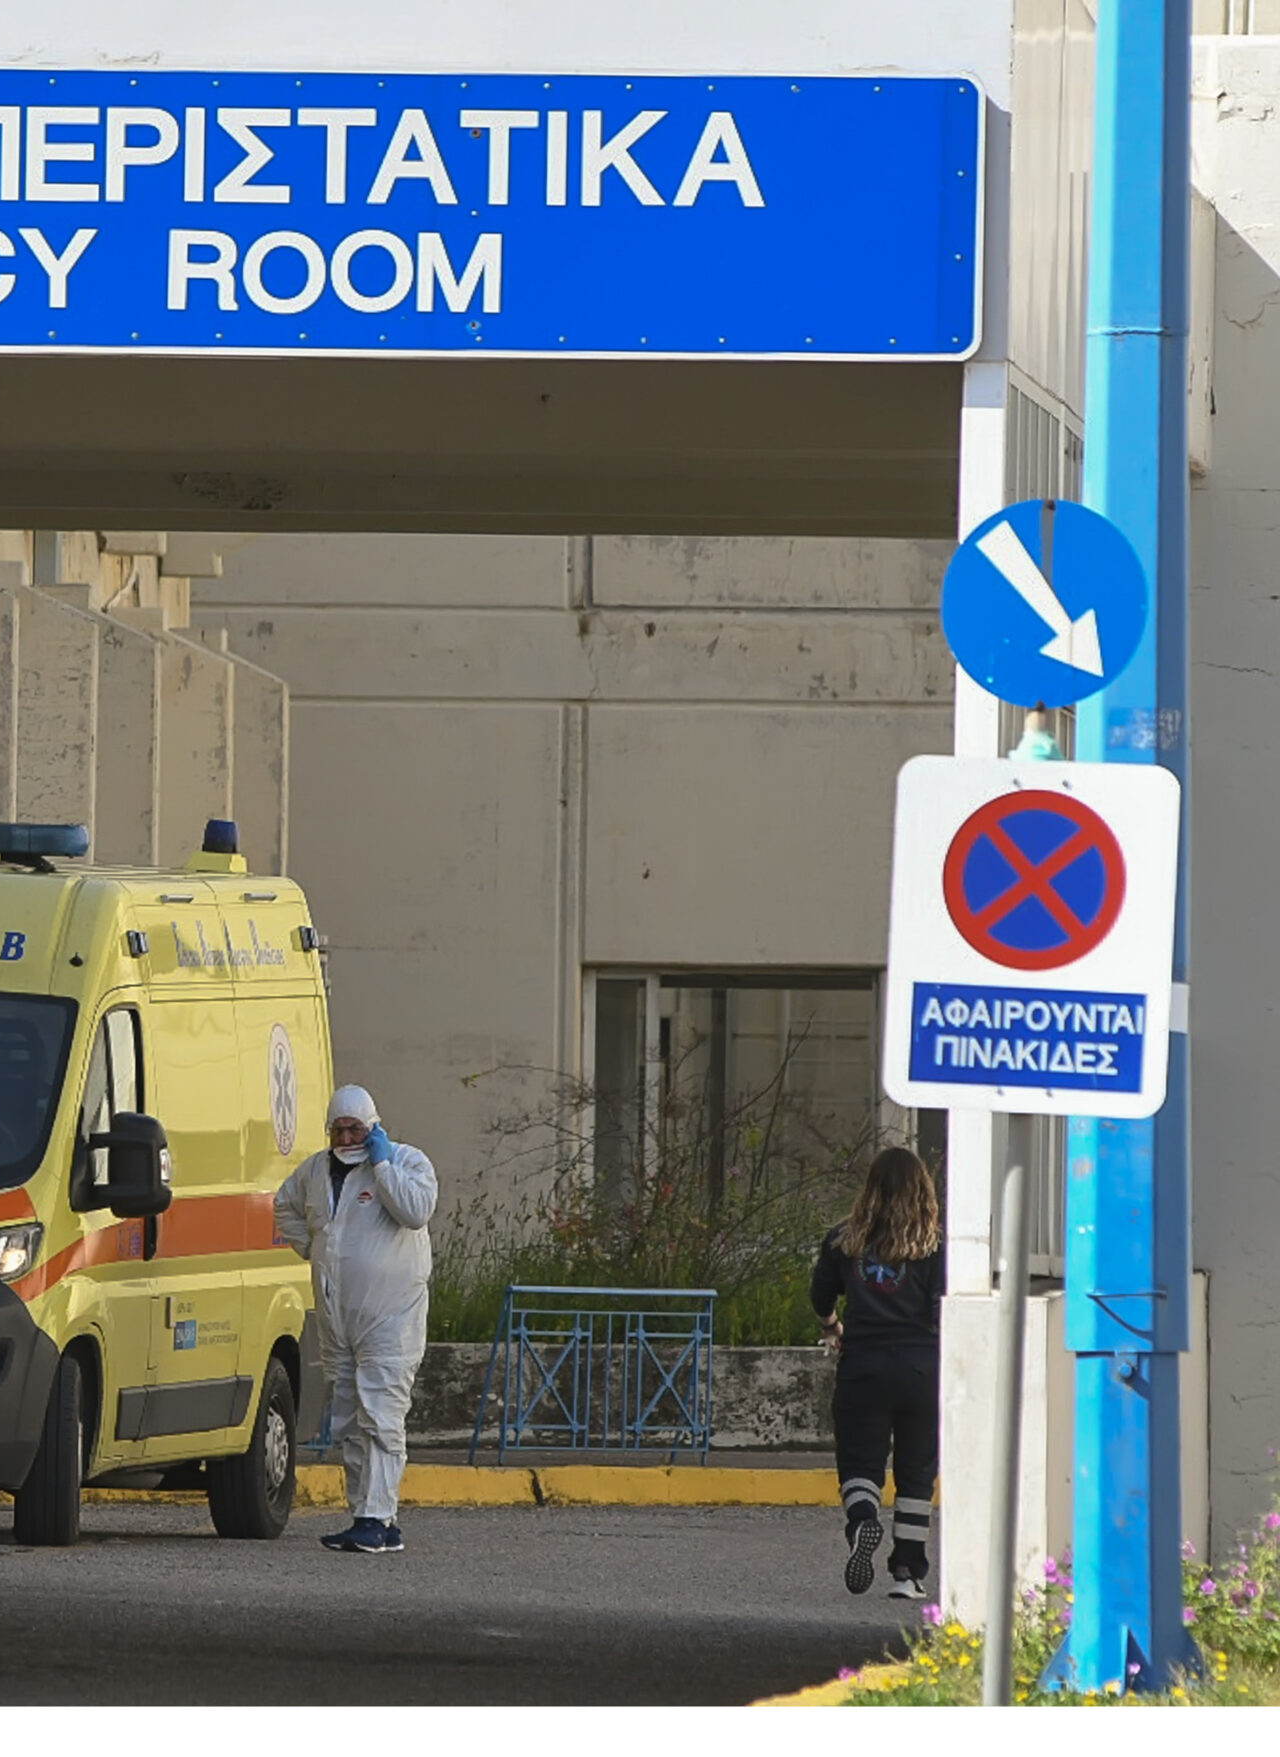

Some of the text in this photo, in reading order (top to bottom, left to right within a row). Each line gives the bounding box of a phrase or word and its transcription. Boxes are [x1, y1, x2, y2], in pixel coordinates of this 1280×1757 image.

[167, 229, 502, 314] ROOM
[921, 997, 1143, 1036] ΑΦΑΙΡΟΥΝΤΑΙ
[935, 1034, 1119, 1076] ΠΙΝΑΚΙΔΕΣ
